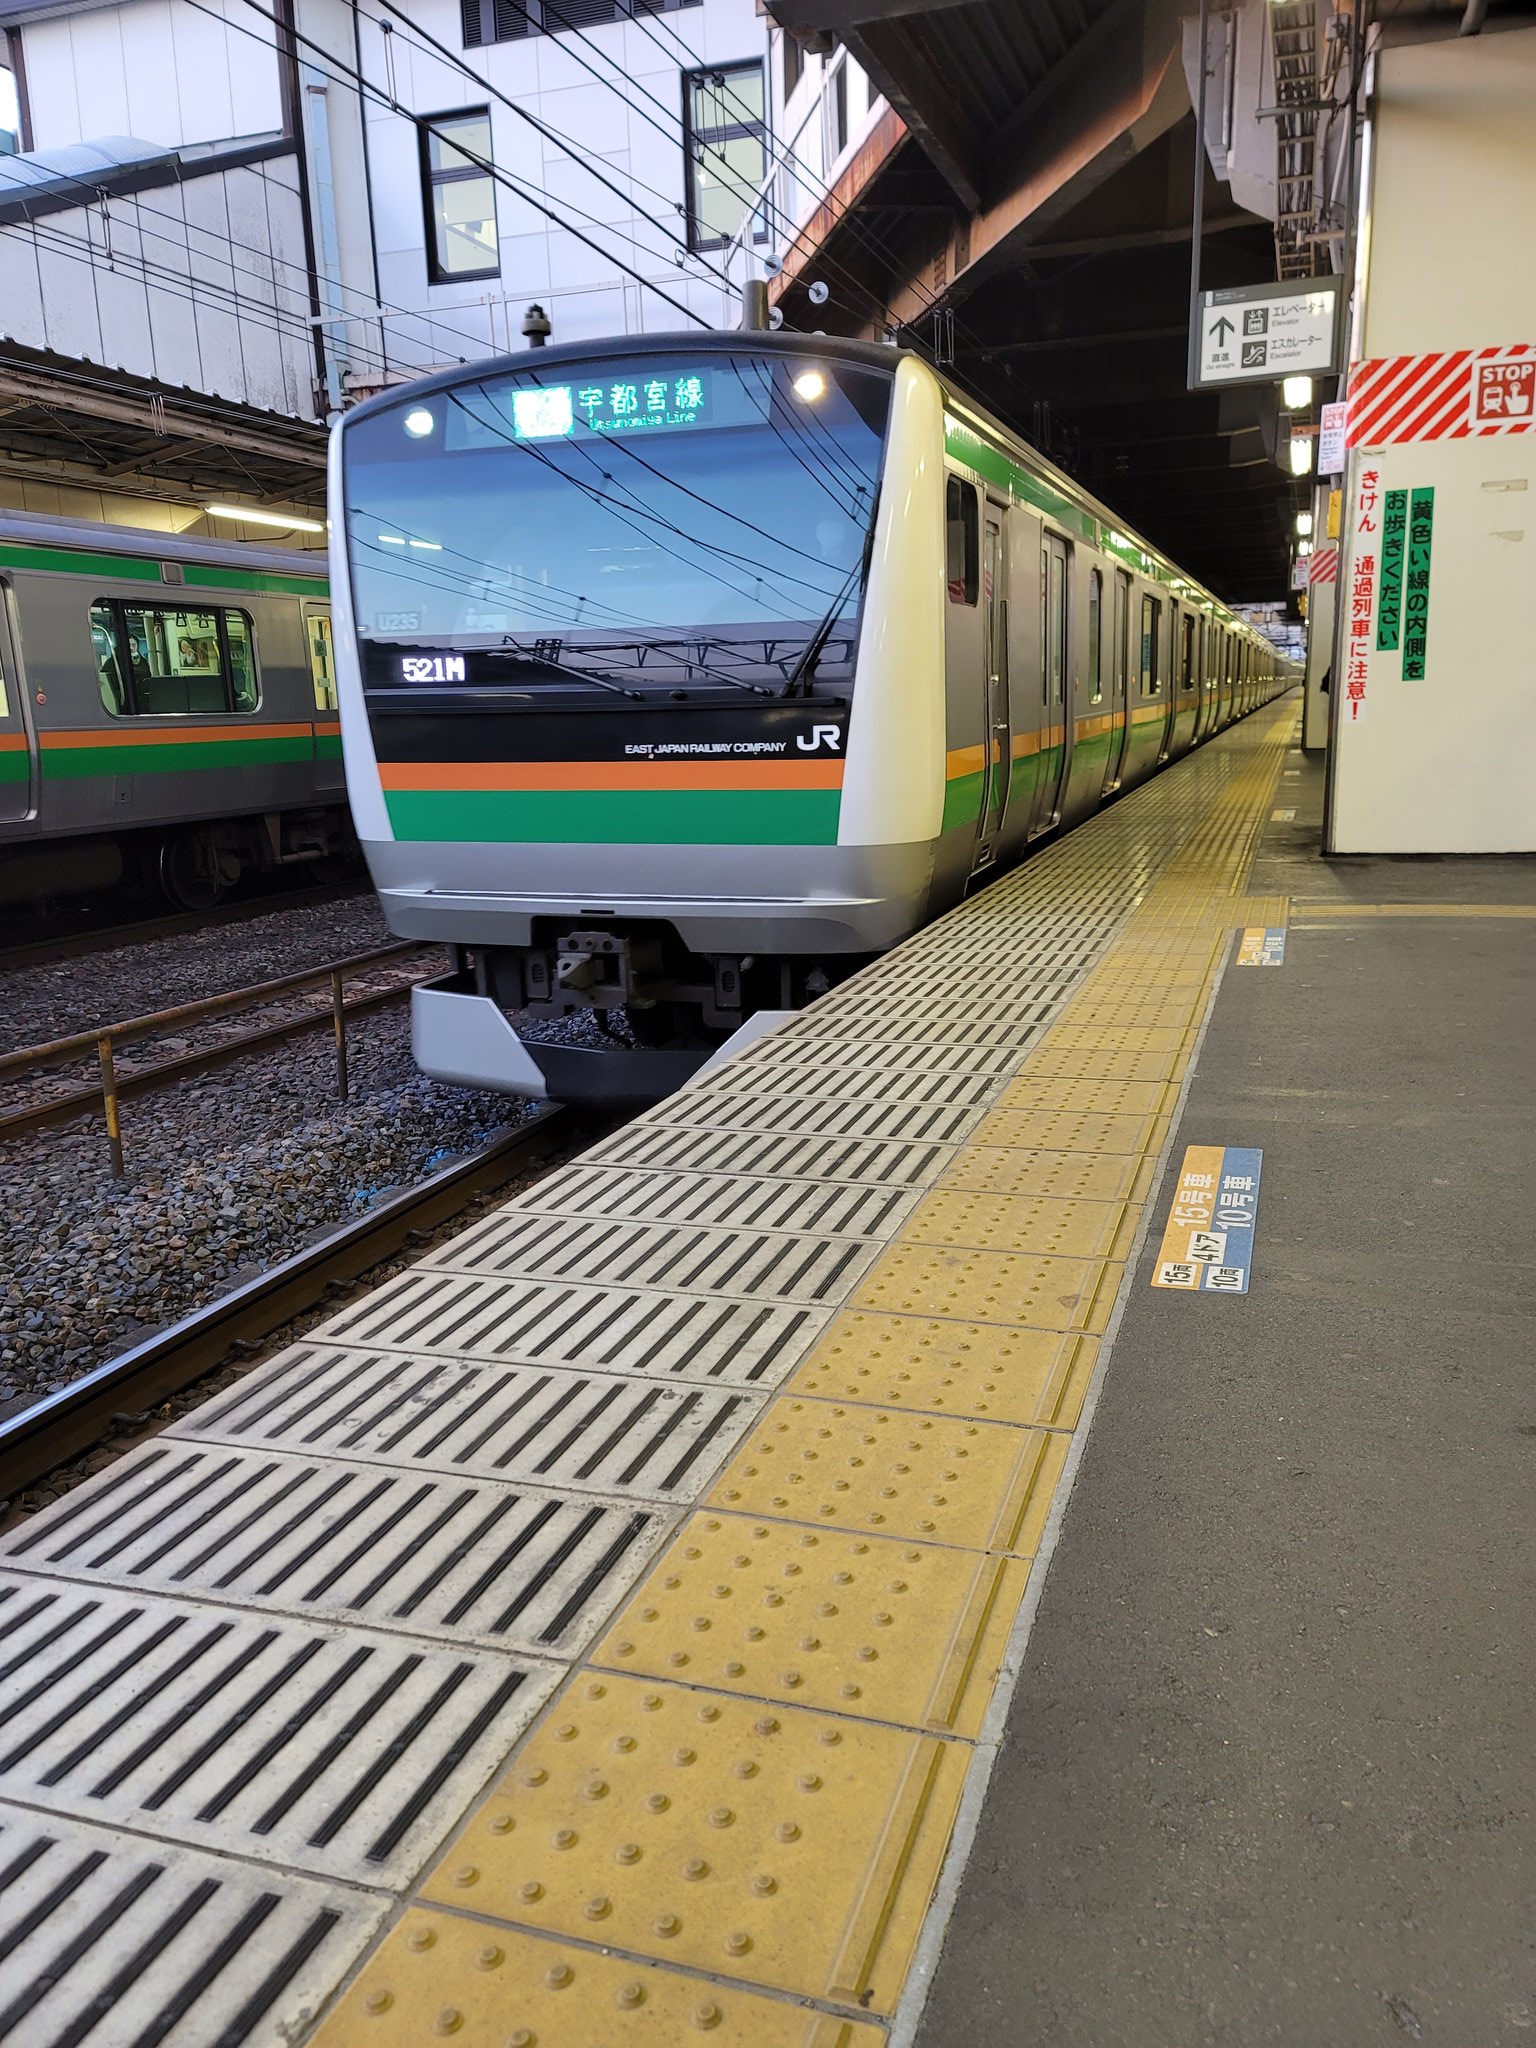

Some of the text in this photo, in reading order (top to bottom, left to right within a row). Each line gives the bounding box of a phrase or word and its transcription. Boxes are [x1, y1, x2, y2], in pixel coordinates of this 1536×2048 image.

[1273, 302, 1325, 317] エレベーター
[1271, 318, 1299, 327] Elevator
[1271, 335, 1322, 350] エスカレーター
[1270, 350, 1302, 360] Escalator
[1482, 363, 1534, 383] STOP
[578, 376, 704, 418] 宇都宮線
[589, 411, 696, 431] Utsunomiya Line
[1379, 491, 1406, 648] お歩きください
[1346, 470, 1379, 721] きけん 通過列車に注意!
[1405, 500, 1433, 679] 黄色い線の内側を
[402, 657, 465, 682] 521M
[625, 742, 787, 754] EAST JAPAN RAILWAY COMPANY
[796, 724, 841, 751] JR
[1173, 1172, 1216, 1227] 15号車
[1215, 1175, 1256, 1230] 10号車
[1191, 1233, 1220, 1262] 4ドア
[1163, 1264, 1193, 1283] 15両
[1211, 1268, 1240, 1287] 10両
